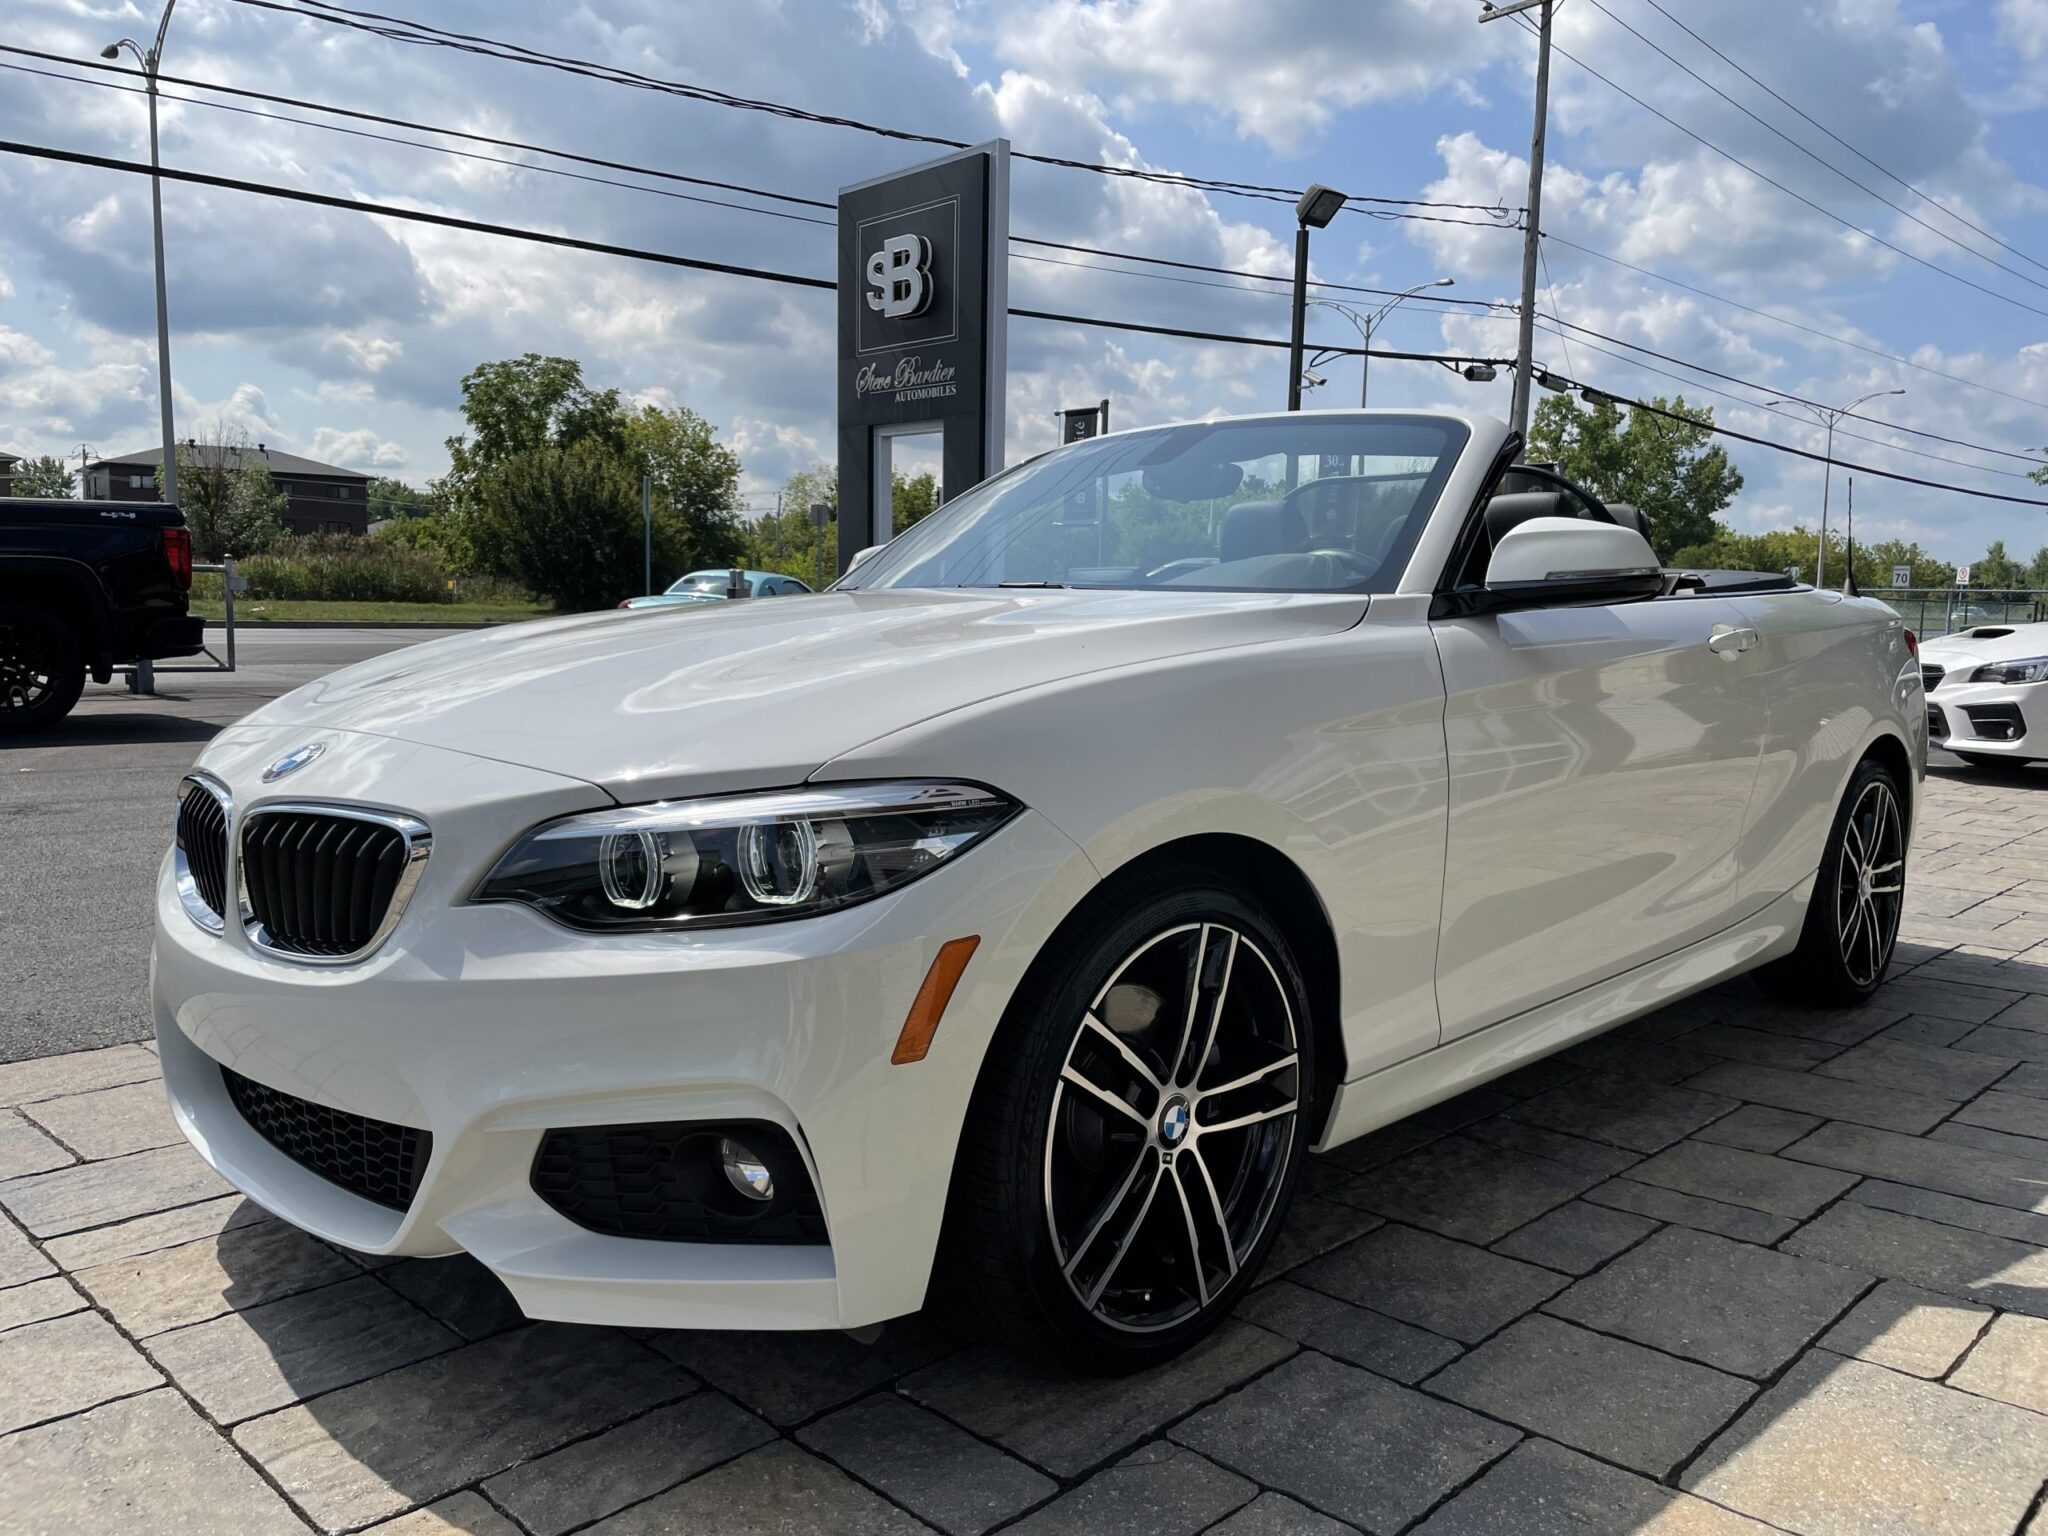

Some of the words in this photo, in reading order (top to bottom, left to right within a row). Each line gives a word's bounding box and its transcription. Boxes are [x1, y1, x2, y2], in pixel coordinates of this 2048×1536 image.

[894, 356, 955, 388] Bardier
[895, 385, 956, 402] AUTOMOBILES
[1895, 573, 1908, 584] 70
